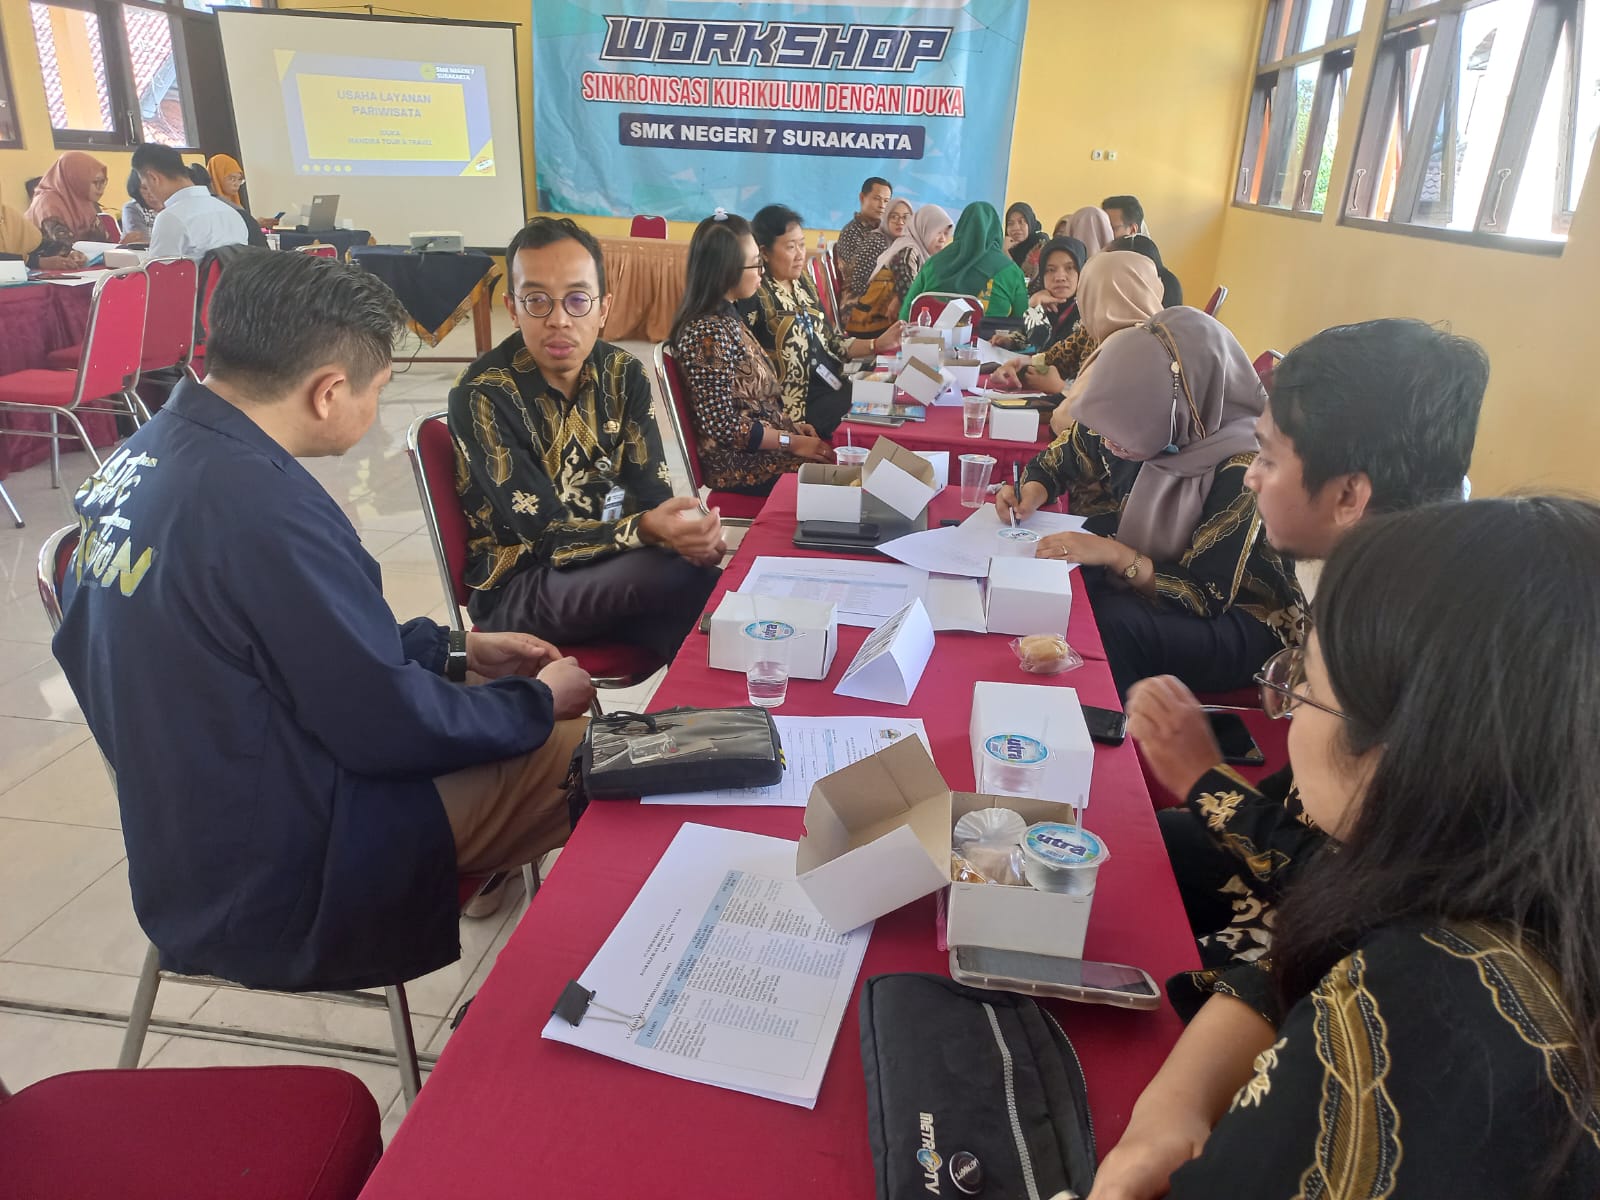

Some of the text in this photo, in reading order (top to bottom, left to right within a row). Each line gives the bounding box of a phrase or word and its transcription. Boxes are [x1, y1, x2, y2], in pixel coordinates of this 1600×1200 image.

[600, 15, 954, 73] WORKSHOP
[336, 90, 432, 104] USAHA LAYANAN
[582, 72, 964, 117] SINKRONISASI KURIKULUM DENGAN IDUKA
[352, 105, 422, 118] PARIWISATA
[630, 121, 912, 151] SMK NEGERI 7 SURAKARTA
[1036, 833, 1087, 857] utra
